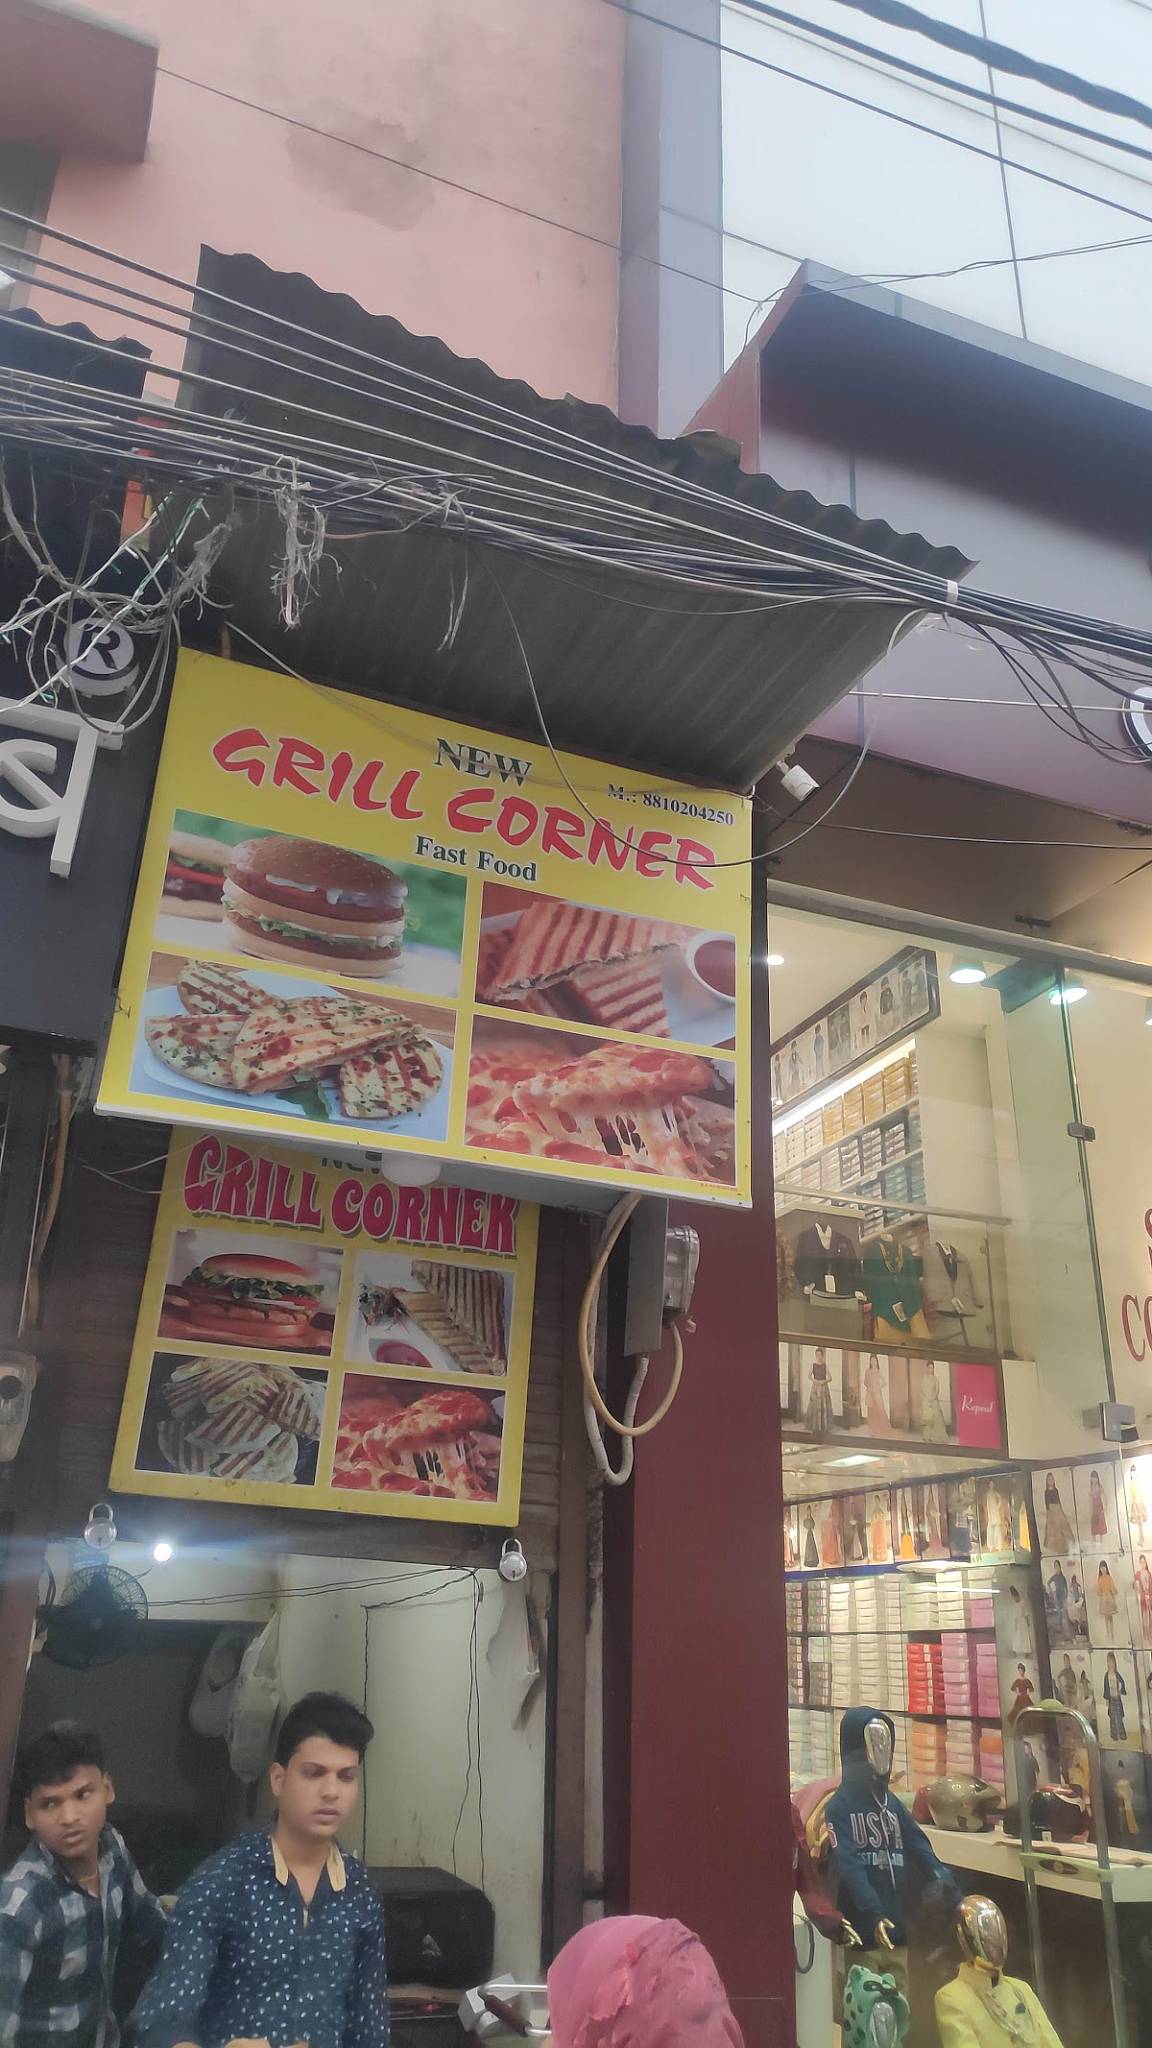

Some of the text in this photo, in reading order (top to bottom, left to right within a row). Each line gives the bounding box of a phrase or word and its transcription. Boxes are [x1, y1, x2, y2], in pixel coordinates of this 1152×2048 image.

[434, 737, 533, 787] NEW
[212, 727, 717, 891] GRILL CORNER
[642, 792, 734, 826] 8810204250
[415, 834, 538, 882] Fast Food
[183, 1132, 324, 1230] GRILL
